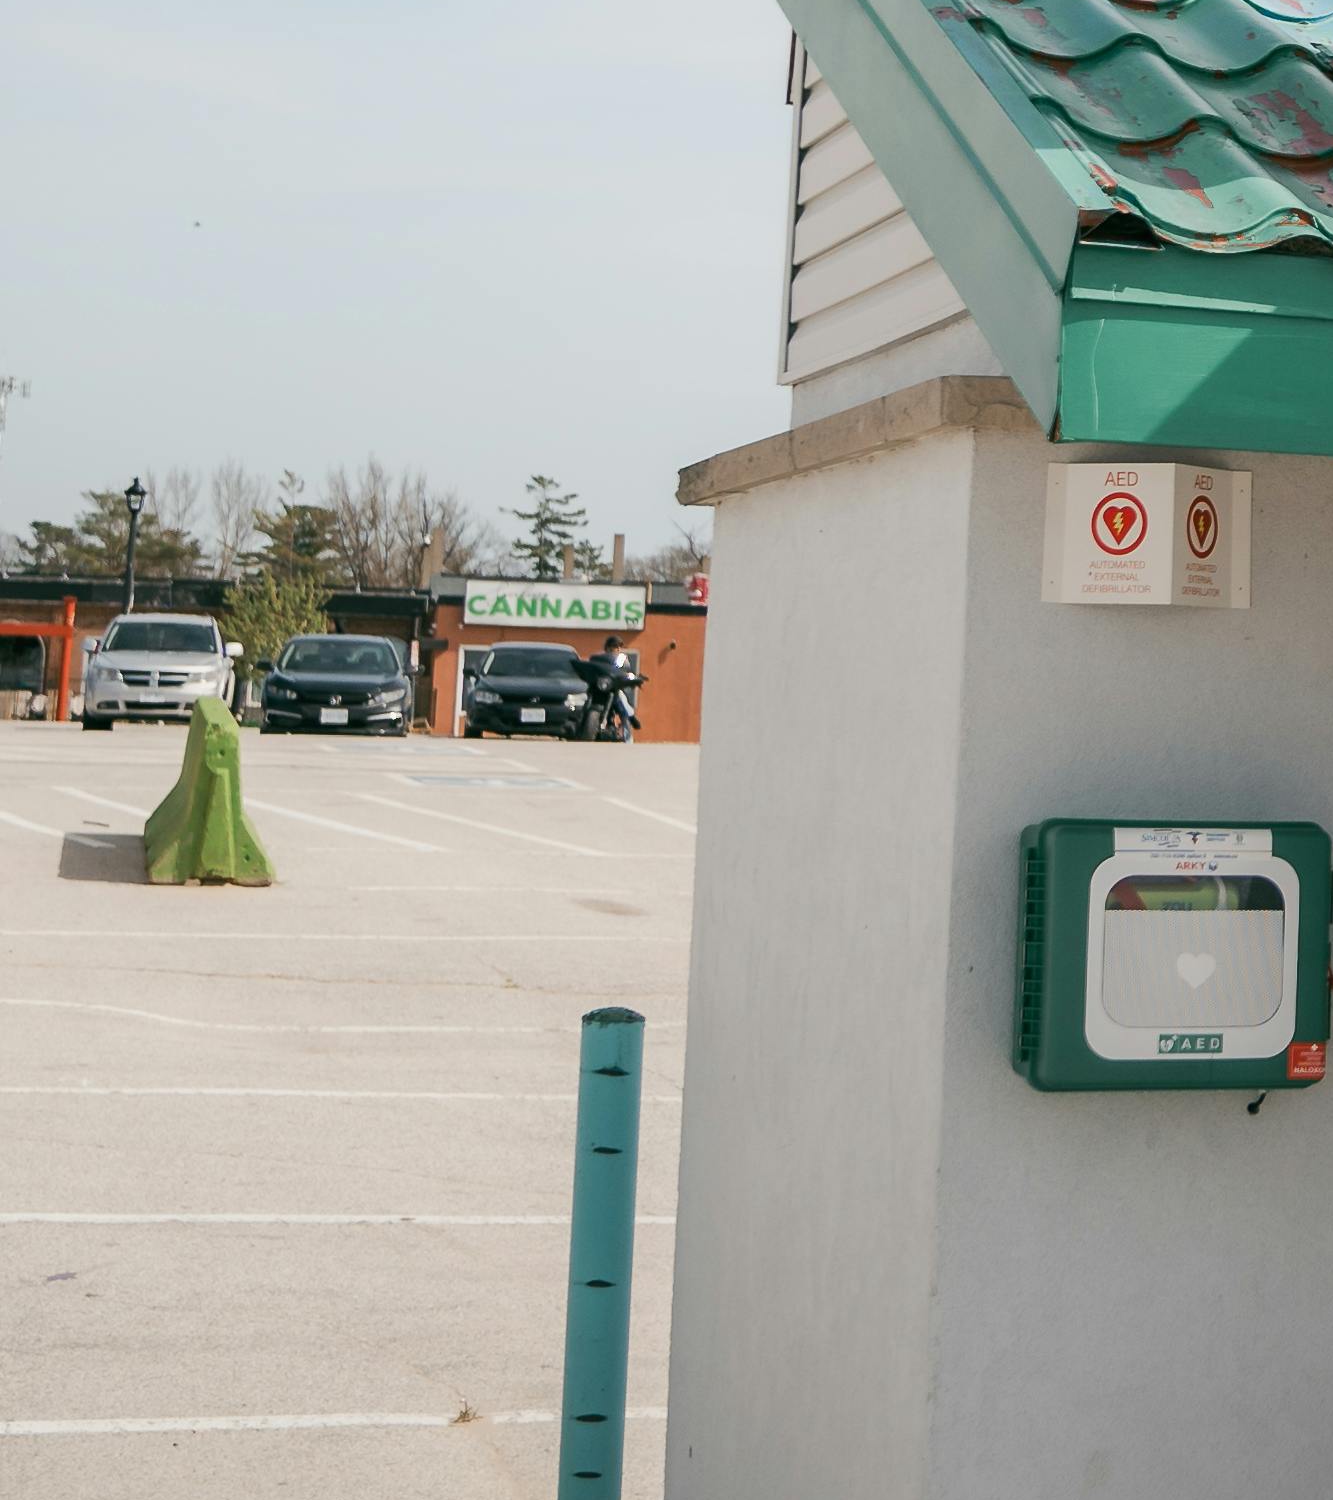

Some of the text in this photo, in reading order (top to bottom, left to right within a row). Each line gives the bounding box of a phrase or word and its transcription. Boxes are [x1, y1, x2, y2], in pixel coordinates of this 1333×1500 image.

[1104, 471, 1139, 487] AED
[1194, 474, 1214, 491] AED
[1089, 560, 1145, 569] AUTOMATED
[1094, 572, 1139, 581] EXTERNAL
[1082, 584, 1152, 593] DEFIBRILLATOR
[467, 594, 643, 620] CANNABIS
[1175, 861, 1206, 870] ARKY
[1181, 1037, 1220, 1049] AED
